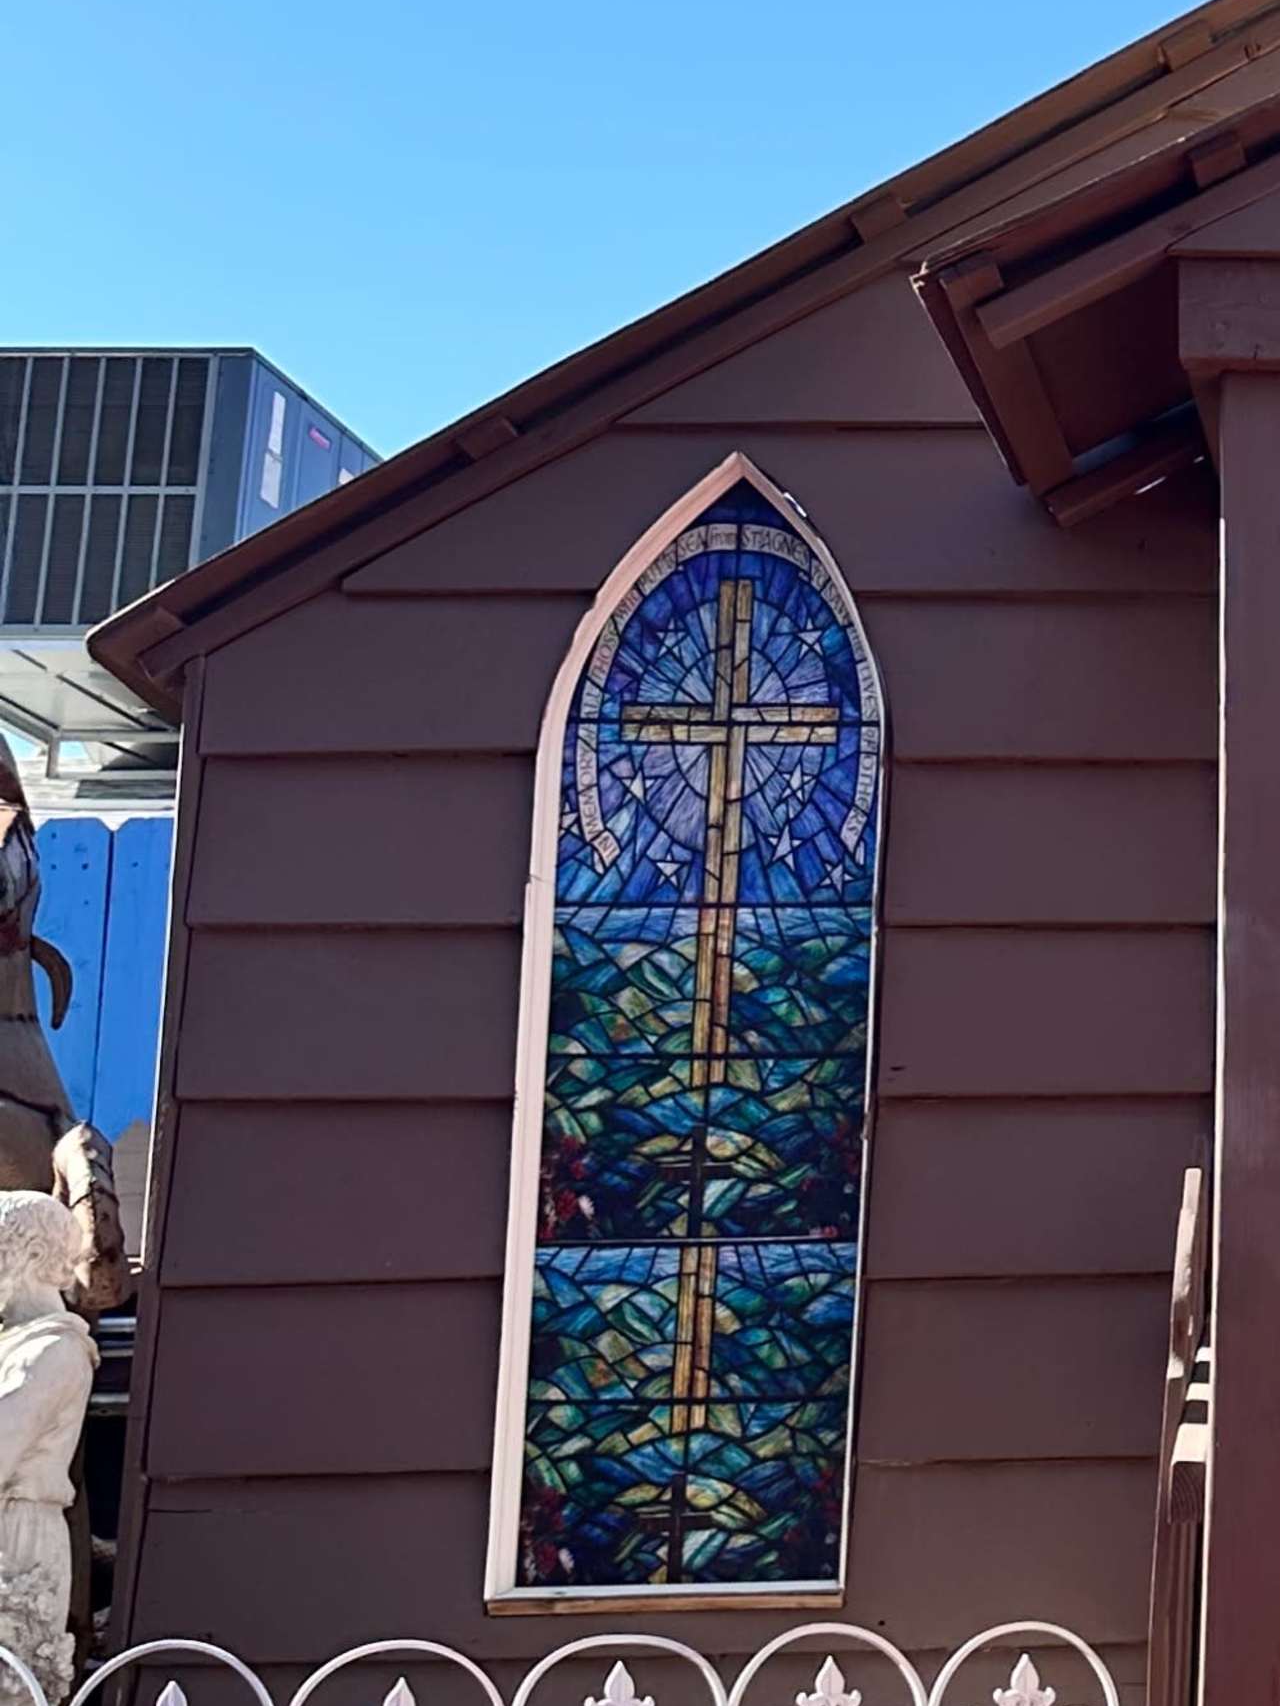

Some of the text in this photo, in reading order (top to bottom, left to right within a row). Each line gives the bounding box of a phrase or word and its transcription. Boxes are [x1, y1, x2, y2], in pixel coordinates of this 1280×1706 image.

[860, 664, 878, 720] LIVES
[579, 748, 601, 835] MEMORY
[847, 757, 876, 837] OTHERS
[601, 834, 616, 859] IN
